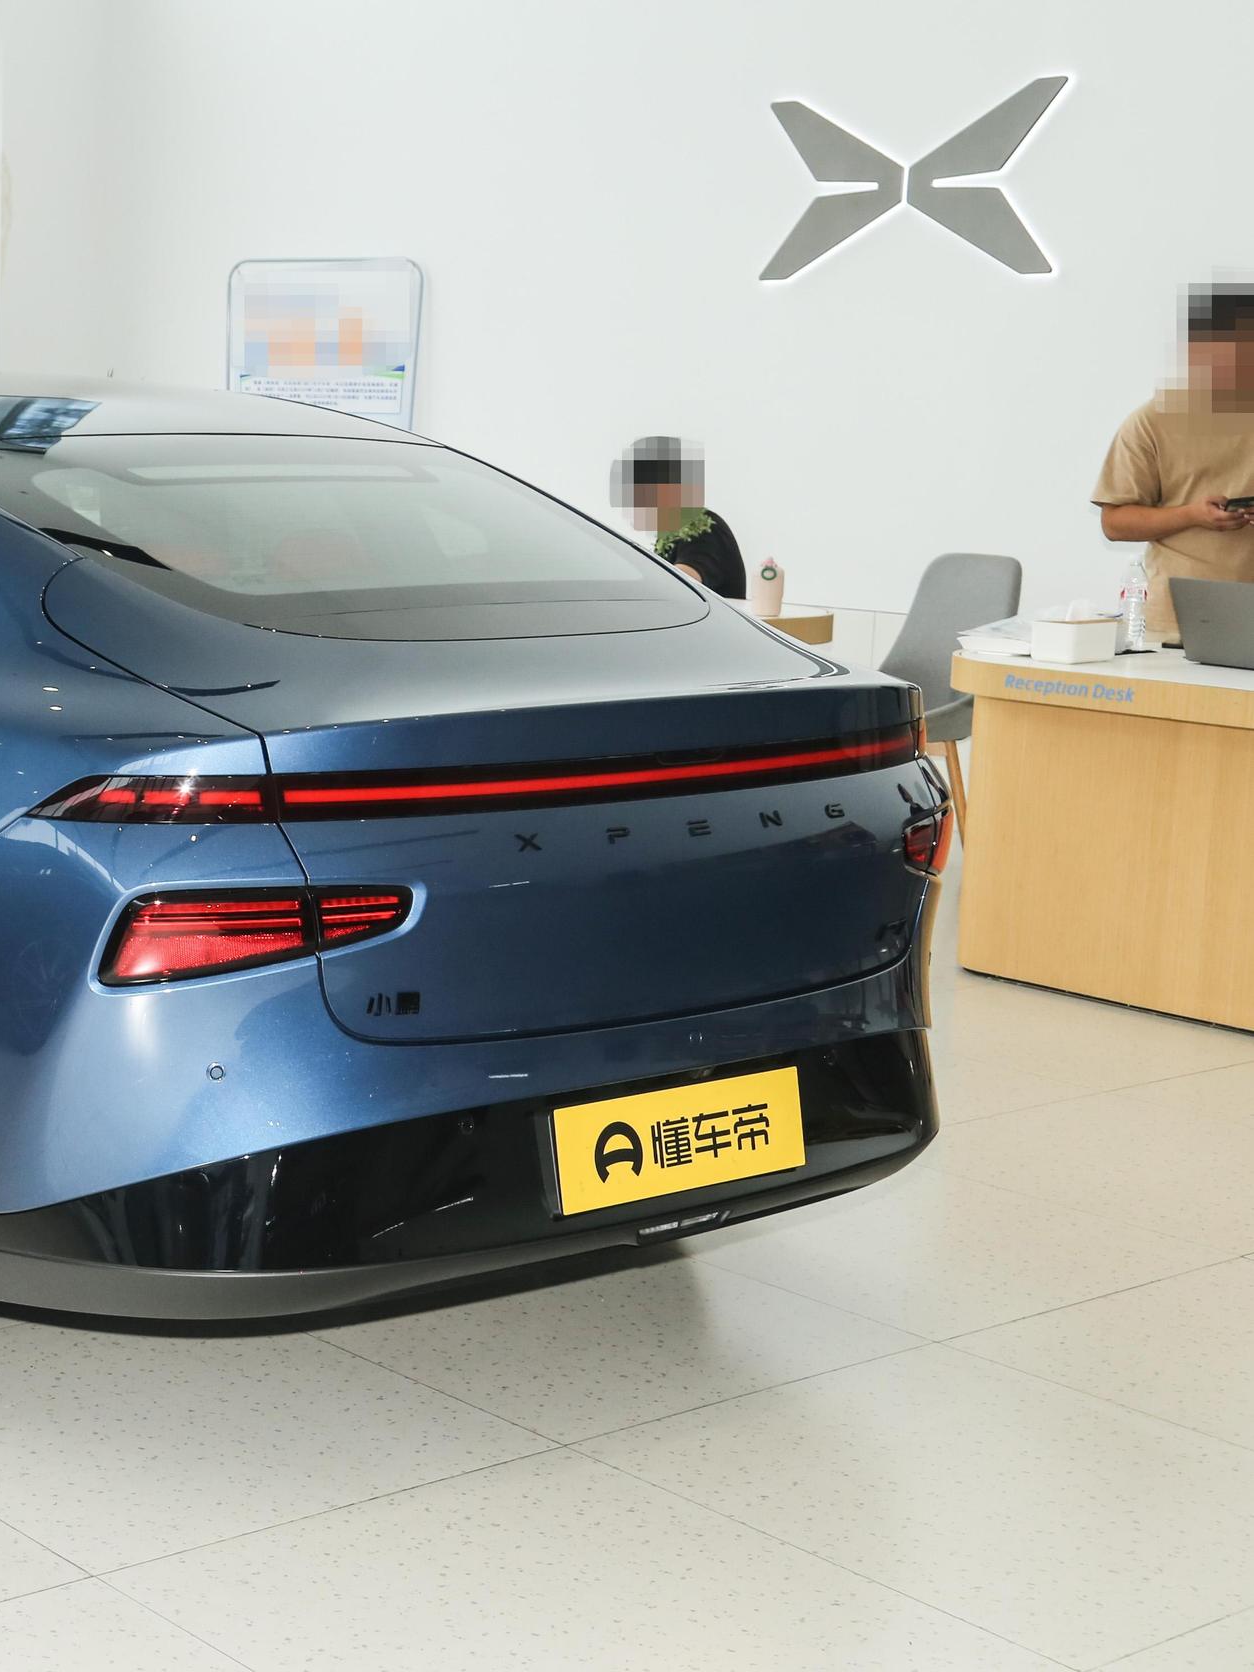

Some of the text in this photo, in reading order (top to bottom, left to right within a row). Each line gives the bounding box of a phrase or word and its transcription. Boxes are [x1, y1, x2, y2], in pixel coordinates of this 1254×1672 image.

[1005, 673, 1134, 702] Reception Desk
[513, 803, 845, 852] XPENG
[650, 1103, 770, 1169] 懂车帝
